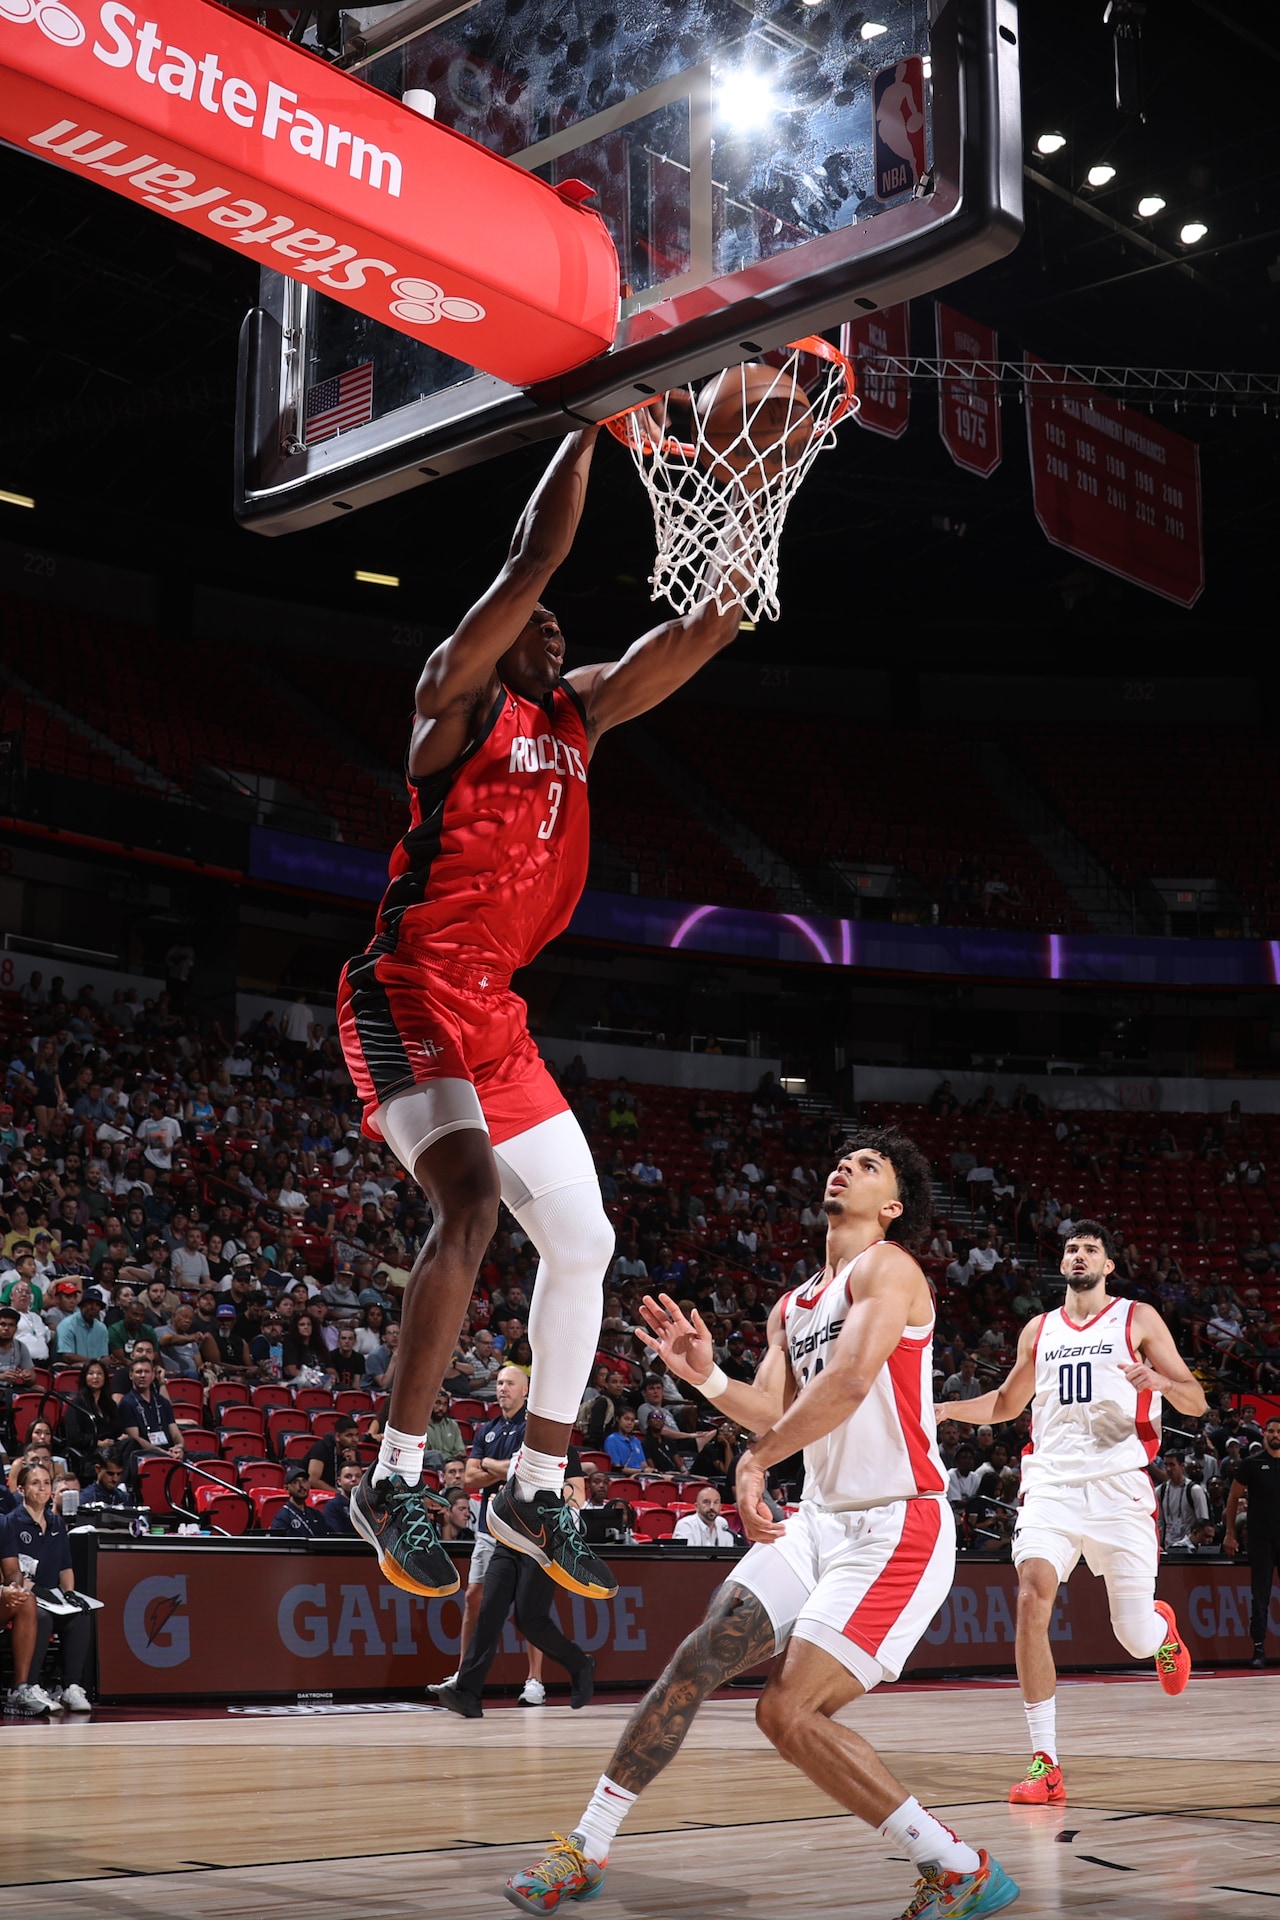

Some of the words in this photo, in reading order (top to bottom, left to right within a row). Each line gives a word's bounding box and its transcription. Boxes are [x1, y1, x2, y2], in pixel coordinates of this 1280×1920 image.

[882, 163, 908, 193] NBA
[955, 406, 987, 448] 1975
[1107, 485, 1127, 512] 2011
[1136, 500, 1156, 527] 2012
[1165, 514, 1185, 541] 2013
[23, 551, 57, 578] 229
[391, 624, 424, 648] 230
[760, 667, 790, 688] 231
[1122, 680, 1156, 701] 232
[508, 733, 588, 784] ROCETS
[537, 781, 563, 840] 3
[1115, 1082, 1155, 1107] 120
[790, 1313, 846, 1361] izards
[1045, 1339, 1115, 1362] wizards
[1059, 1362, 1092, 1406] 00
[123, 1574, 191, 1669] G
